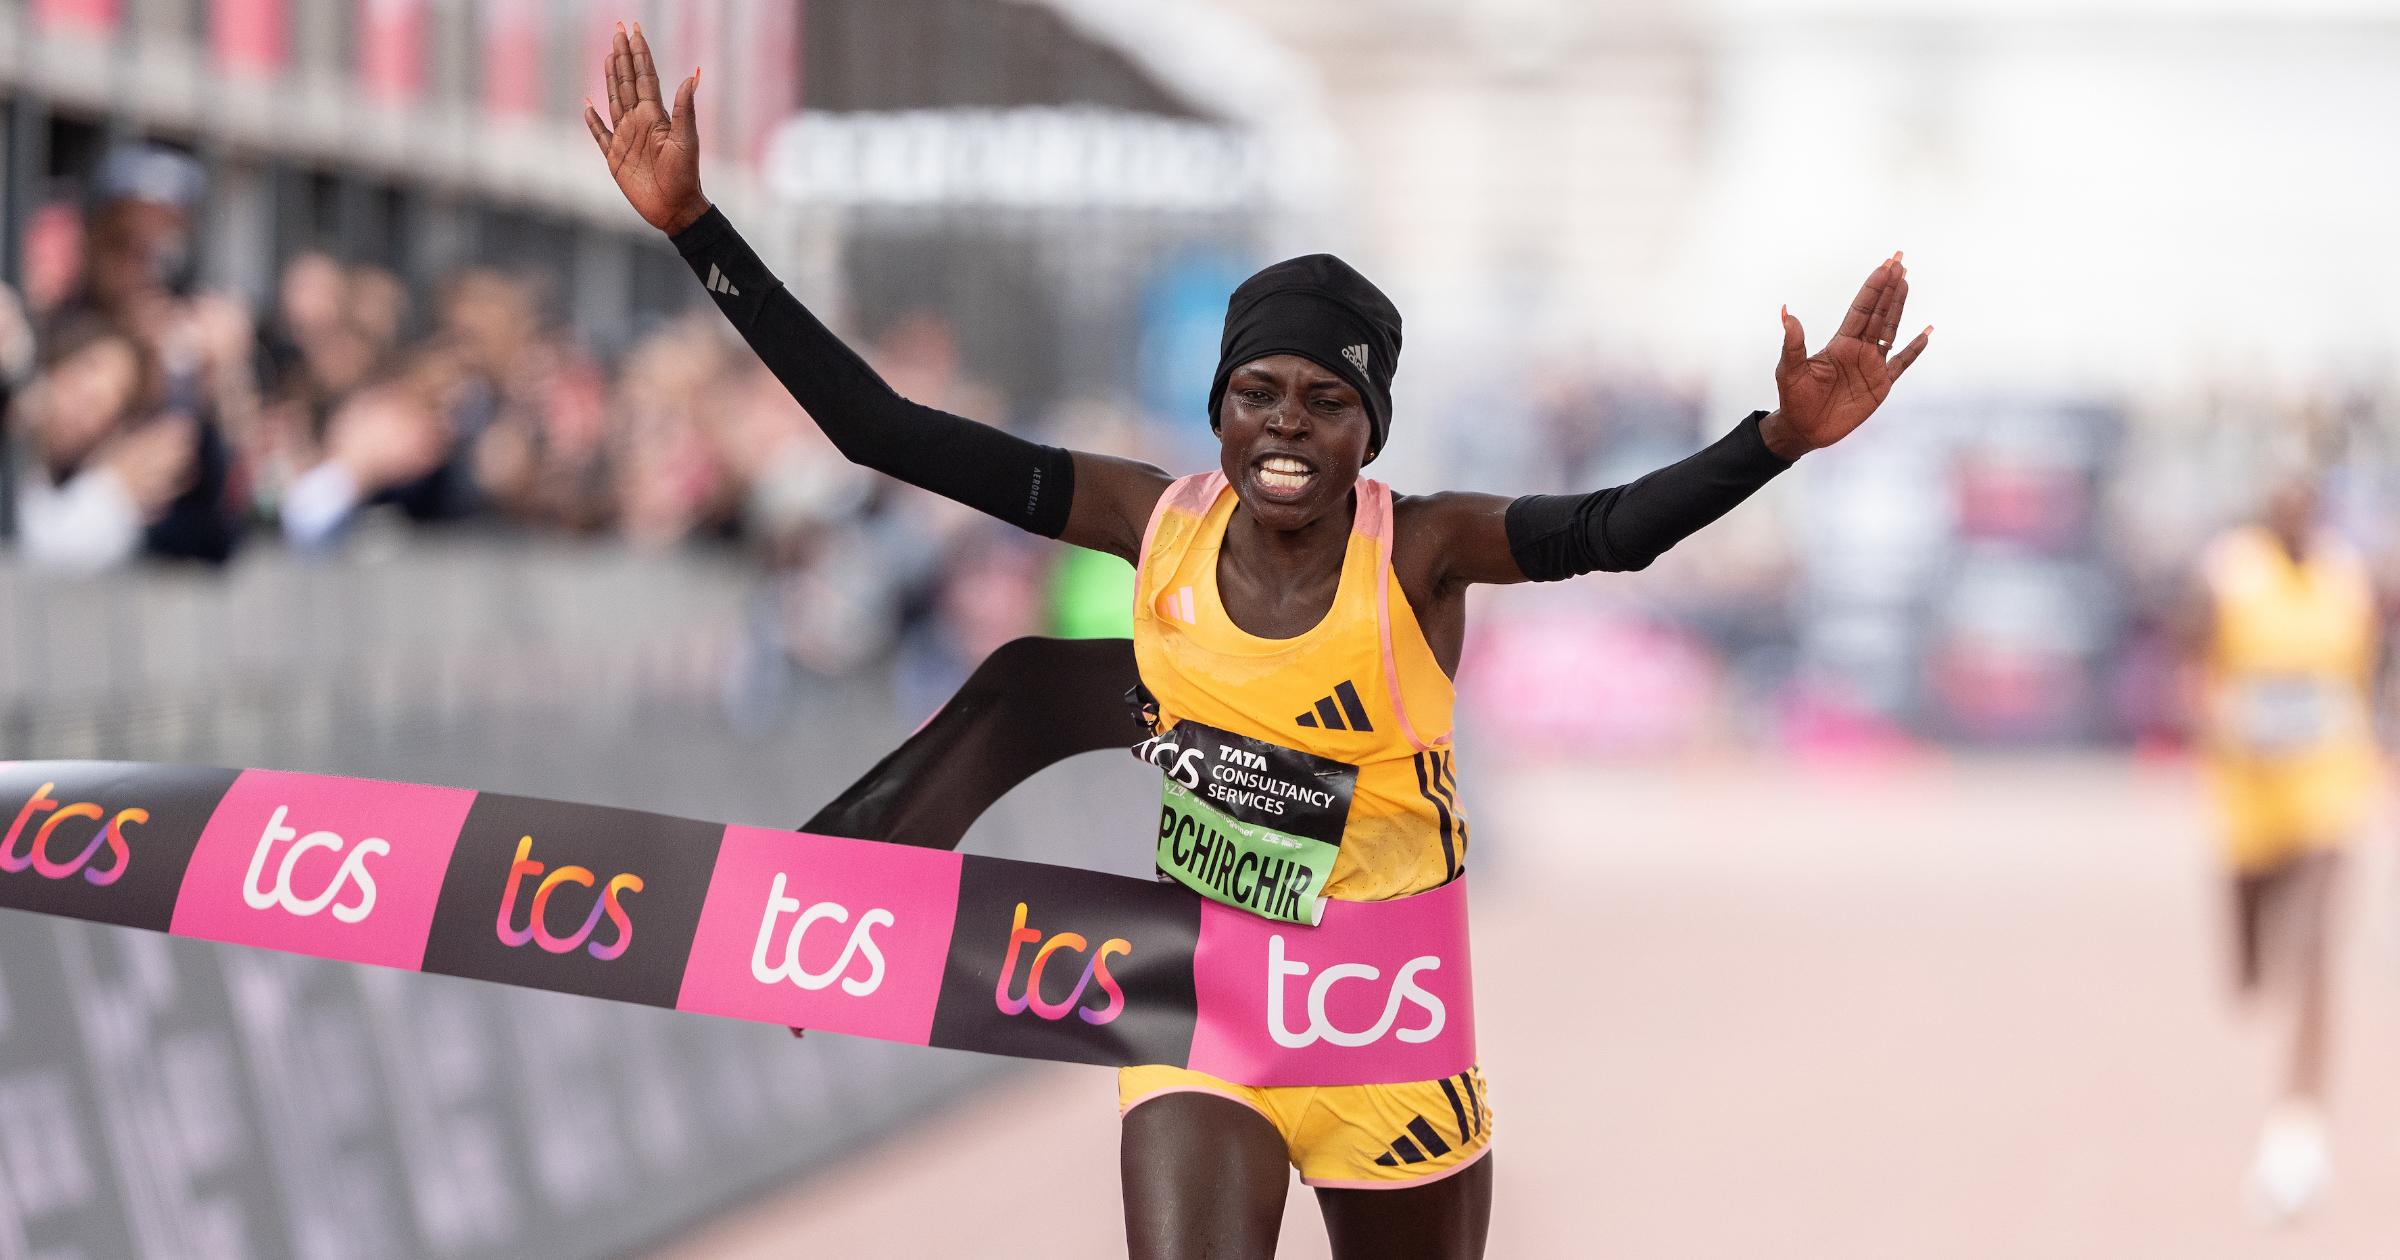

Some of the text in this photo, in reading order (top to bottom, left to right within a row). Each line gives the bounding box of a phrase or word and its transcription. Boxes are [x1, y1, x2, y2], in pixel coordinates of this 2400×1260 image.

[1207, 783, 1286, 816] SERVICES
[1211, 764, 1336, 809] CONSULTANCY
[1218, 744, 1268, 772] TATA
[0, 781, 150, 887] tcs
[242, 804, 391, 924] tcs
[1157, 804, 1313, 922] PCHIRCHIR
[495, 834, 644, 961] tcs
[750, 871, 895, 998] tcs
[994, 901, 1132, 1026] tcs
[1266, 933, 1447, 1049] tcs
